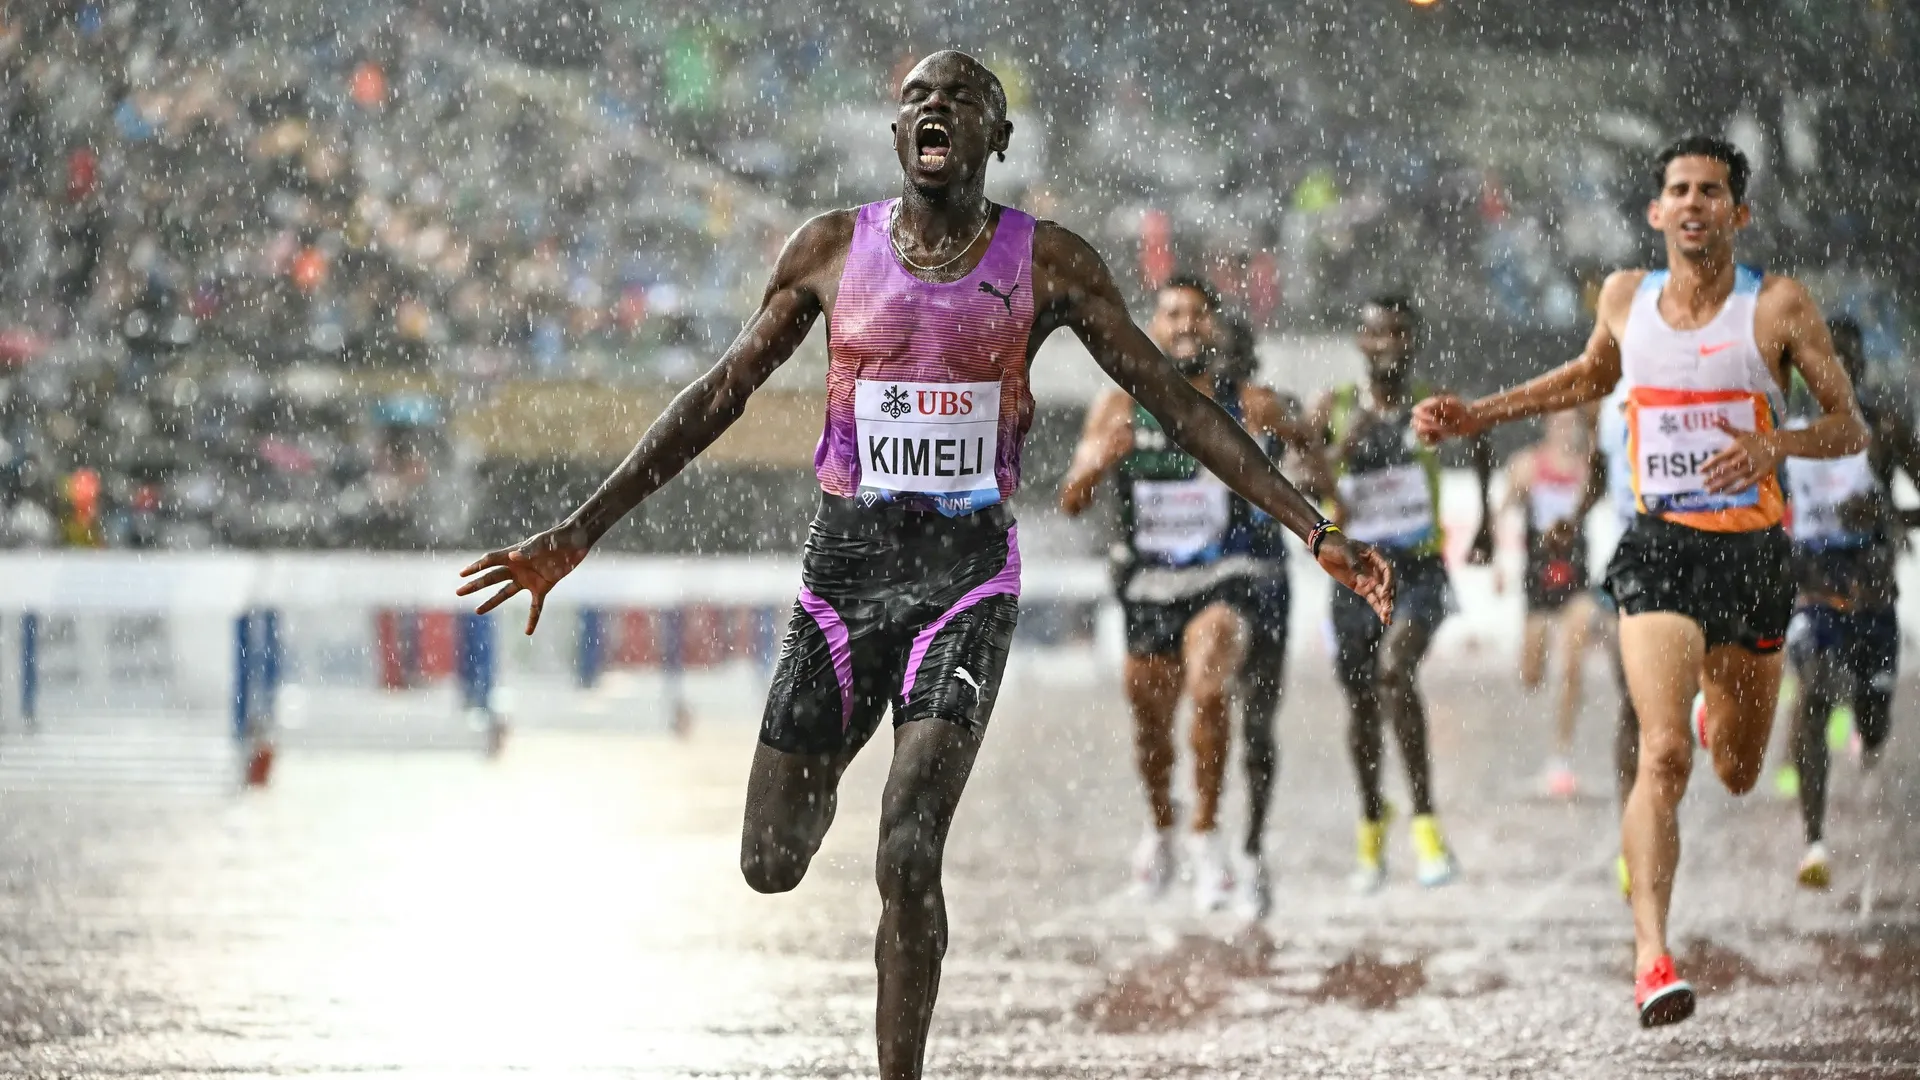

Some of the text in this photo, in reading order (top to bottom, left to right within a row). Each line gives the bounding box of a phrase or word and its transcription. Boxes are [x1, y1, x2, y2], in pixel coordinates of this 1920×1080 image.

[916, 391, 973, 416] UBS
[869, 435, 983, 477] KIMELI
[1647, 449, 1720, 478] FISH
[931, 496, 972, 510] ANNE
